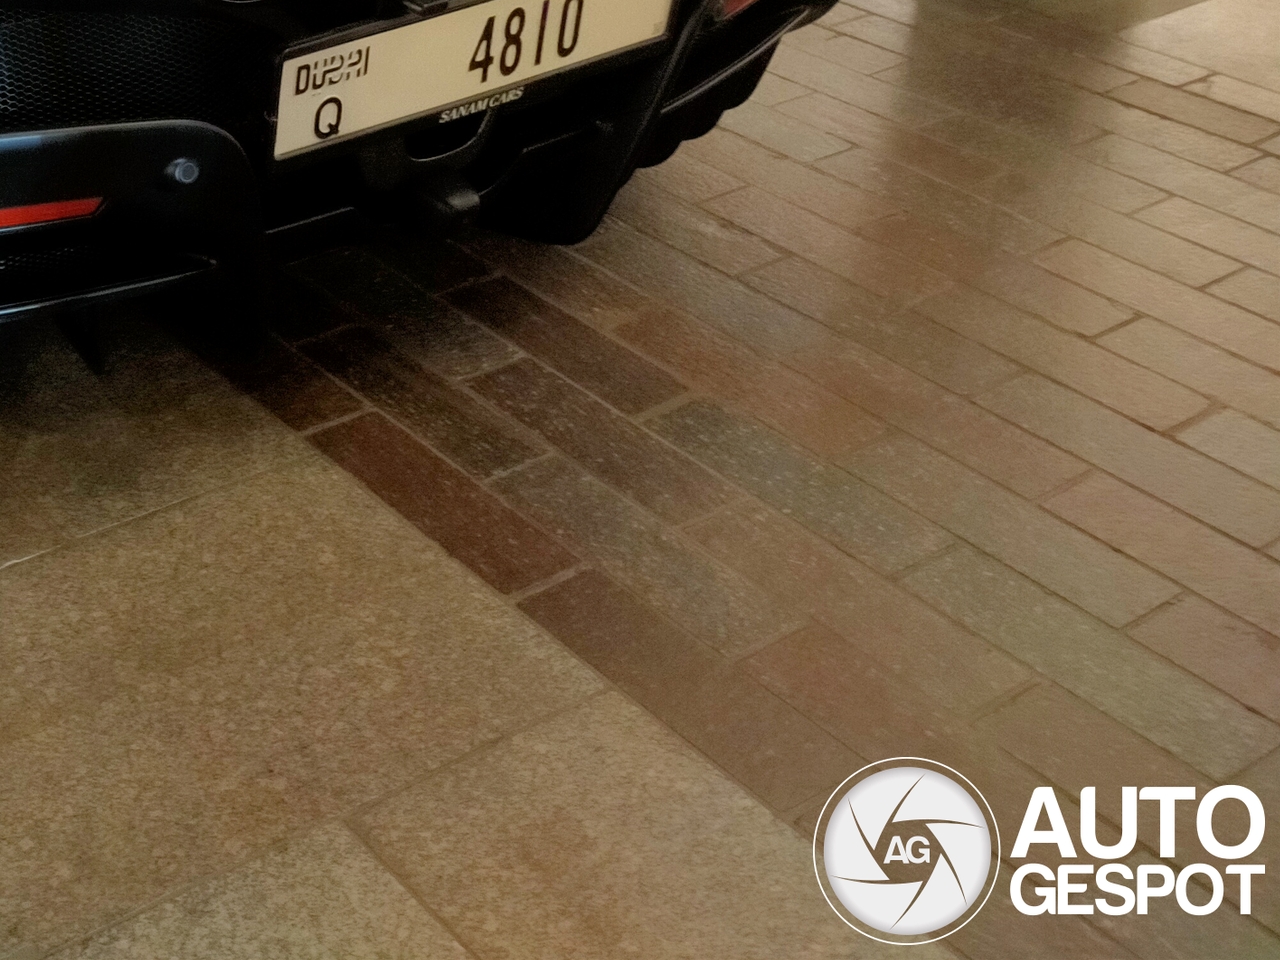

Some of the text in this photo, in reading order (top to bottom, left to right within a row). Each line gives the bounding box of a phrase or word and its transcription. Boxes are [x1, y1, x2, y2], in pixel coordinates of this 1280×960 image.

[293, 45, 370, 96] DUBAI
[313, 96, 343, 139] Q
[438, 86, 525, 123] SANAM CARS
